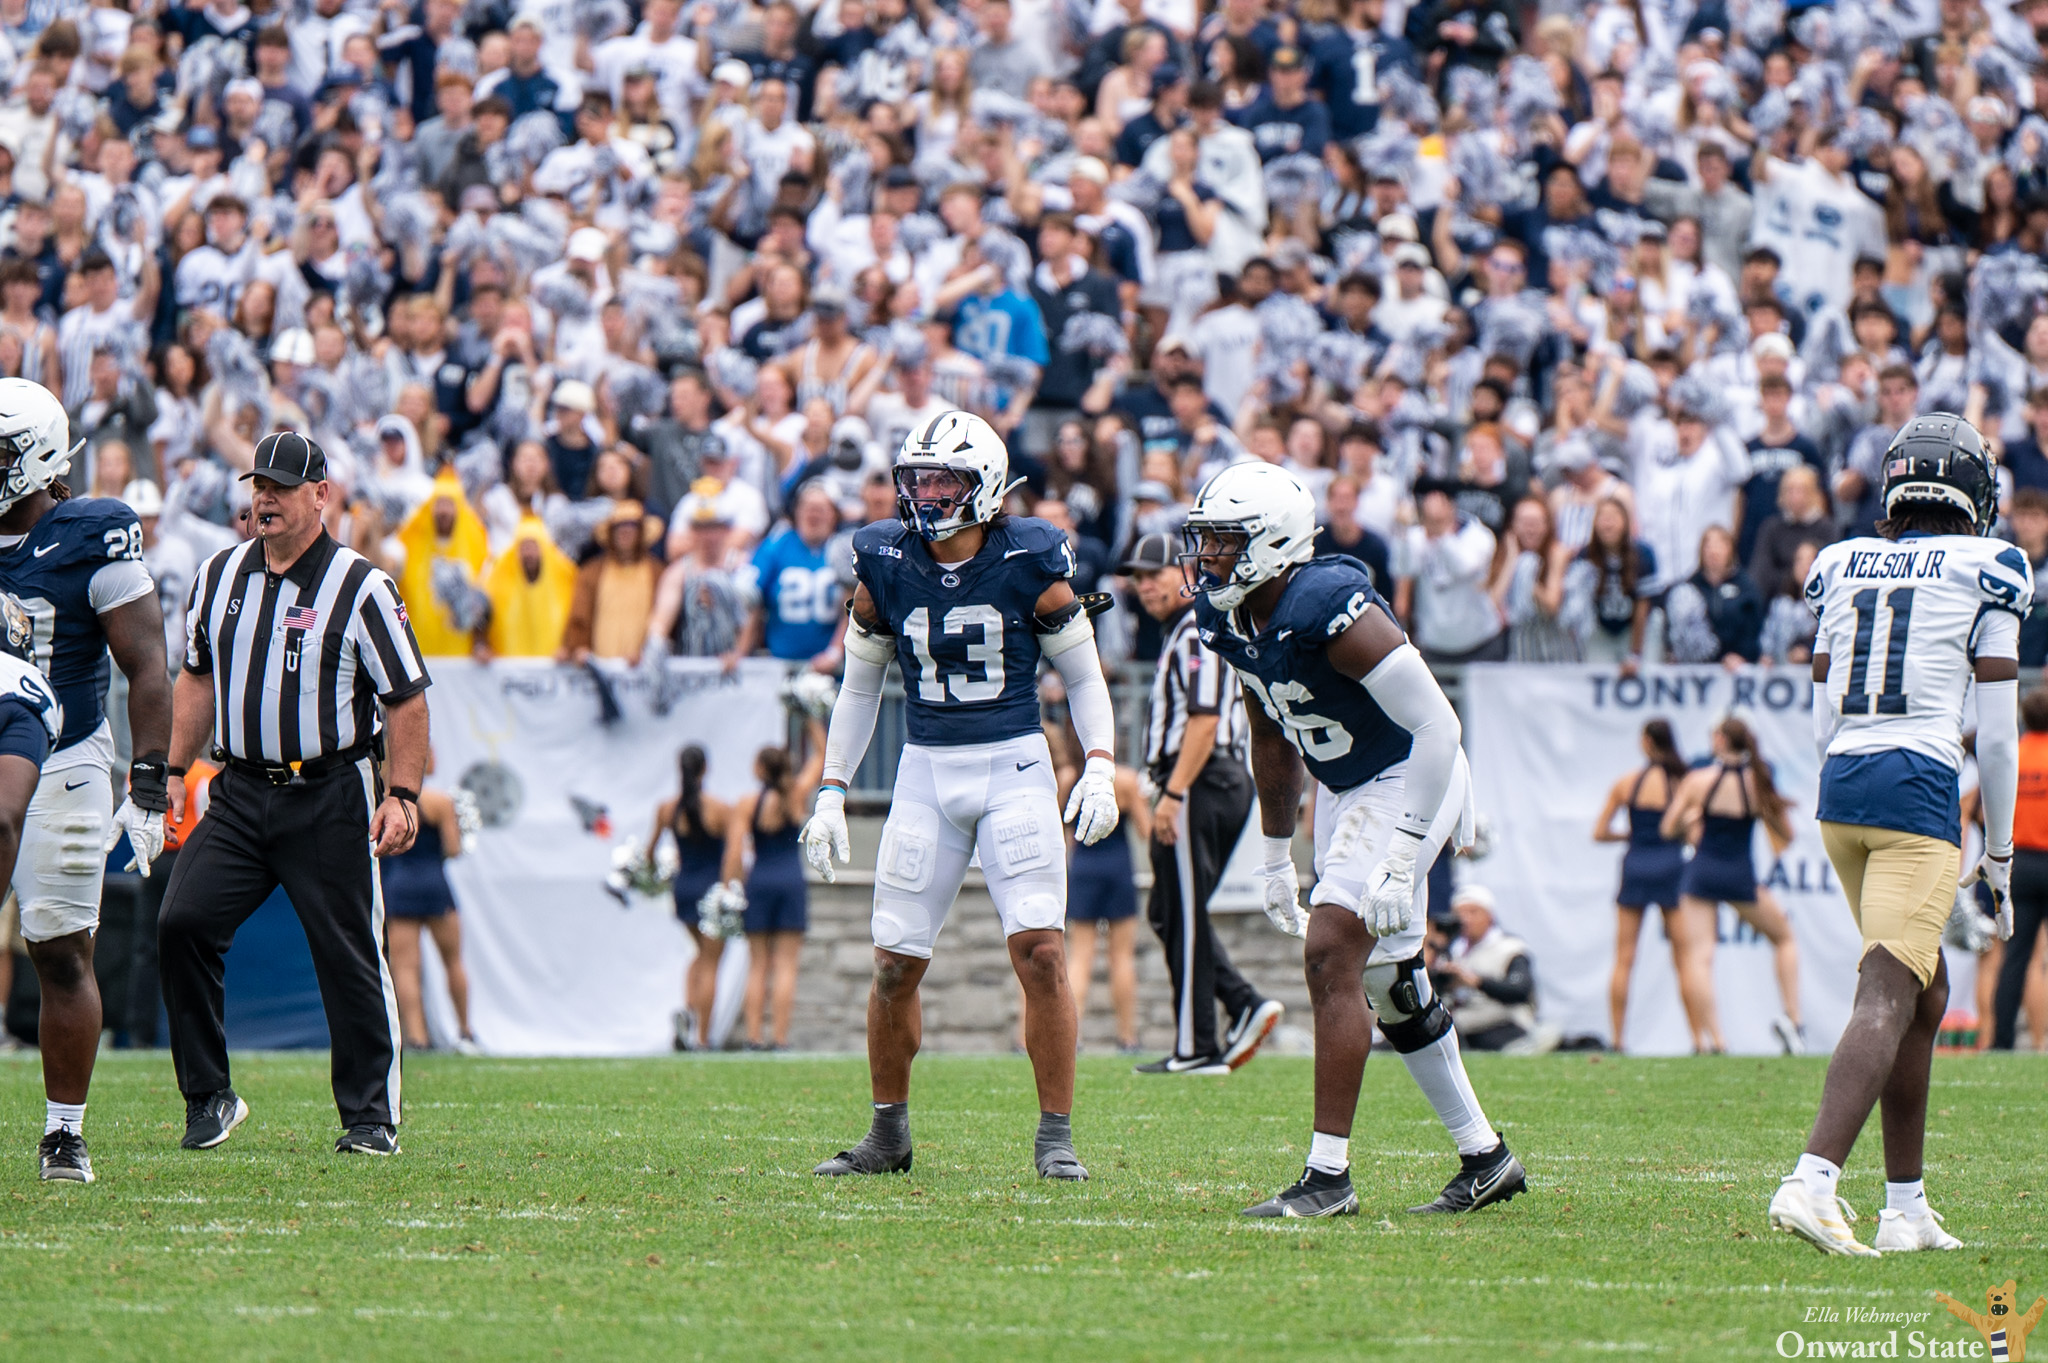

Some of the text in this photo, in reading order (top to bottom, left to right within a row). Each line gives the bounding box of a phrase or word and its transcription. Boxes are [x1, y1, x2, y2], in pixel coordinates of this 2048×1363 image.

[103, 521, 144, 561] 28
[1843, 550, 1946, 579] NELSON JR
[227, 598, 241, 615] S
[903, 604, 1006, 703] 13
[1841, 586, 1916, 716] 11
[1590, 675, 1814, 711] TONY ROJ
[999, 817, 1039, 843] JESUS
[886, 837, 926, 882] 13
[1006, 842, 1041, 866] KING
